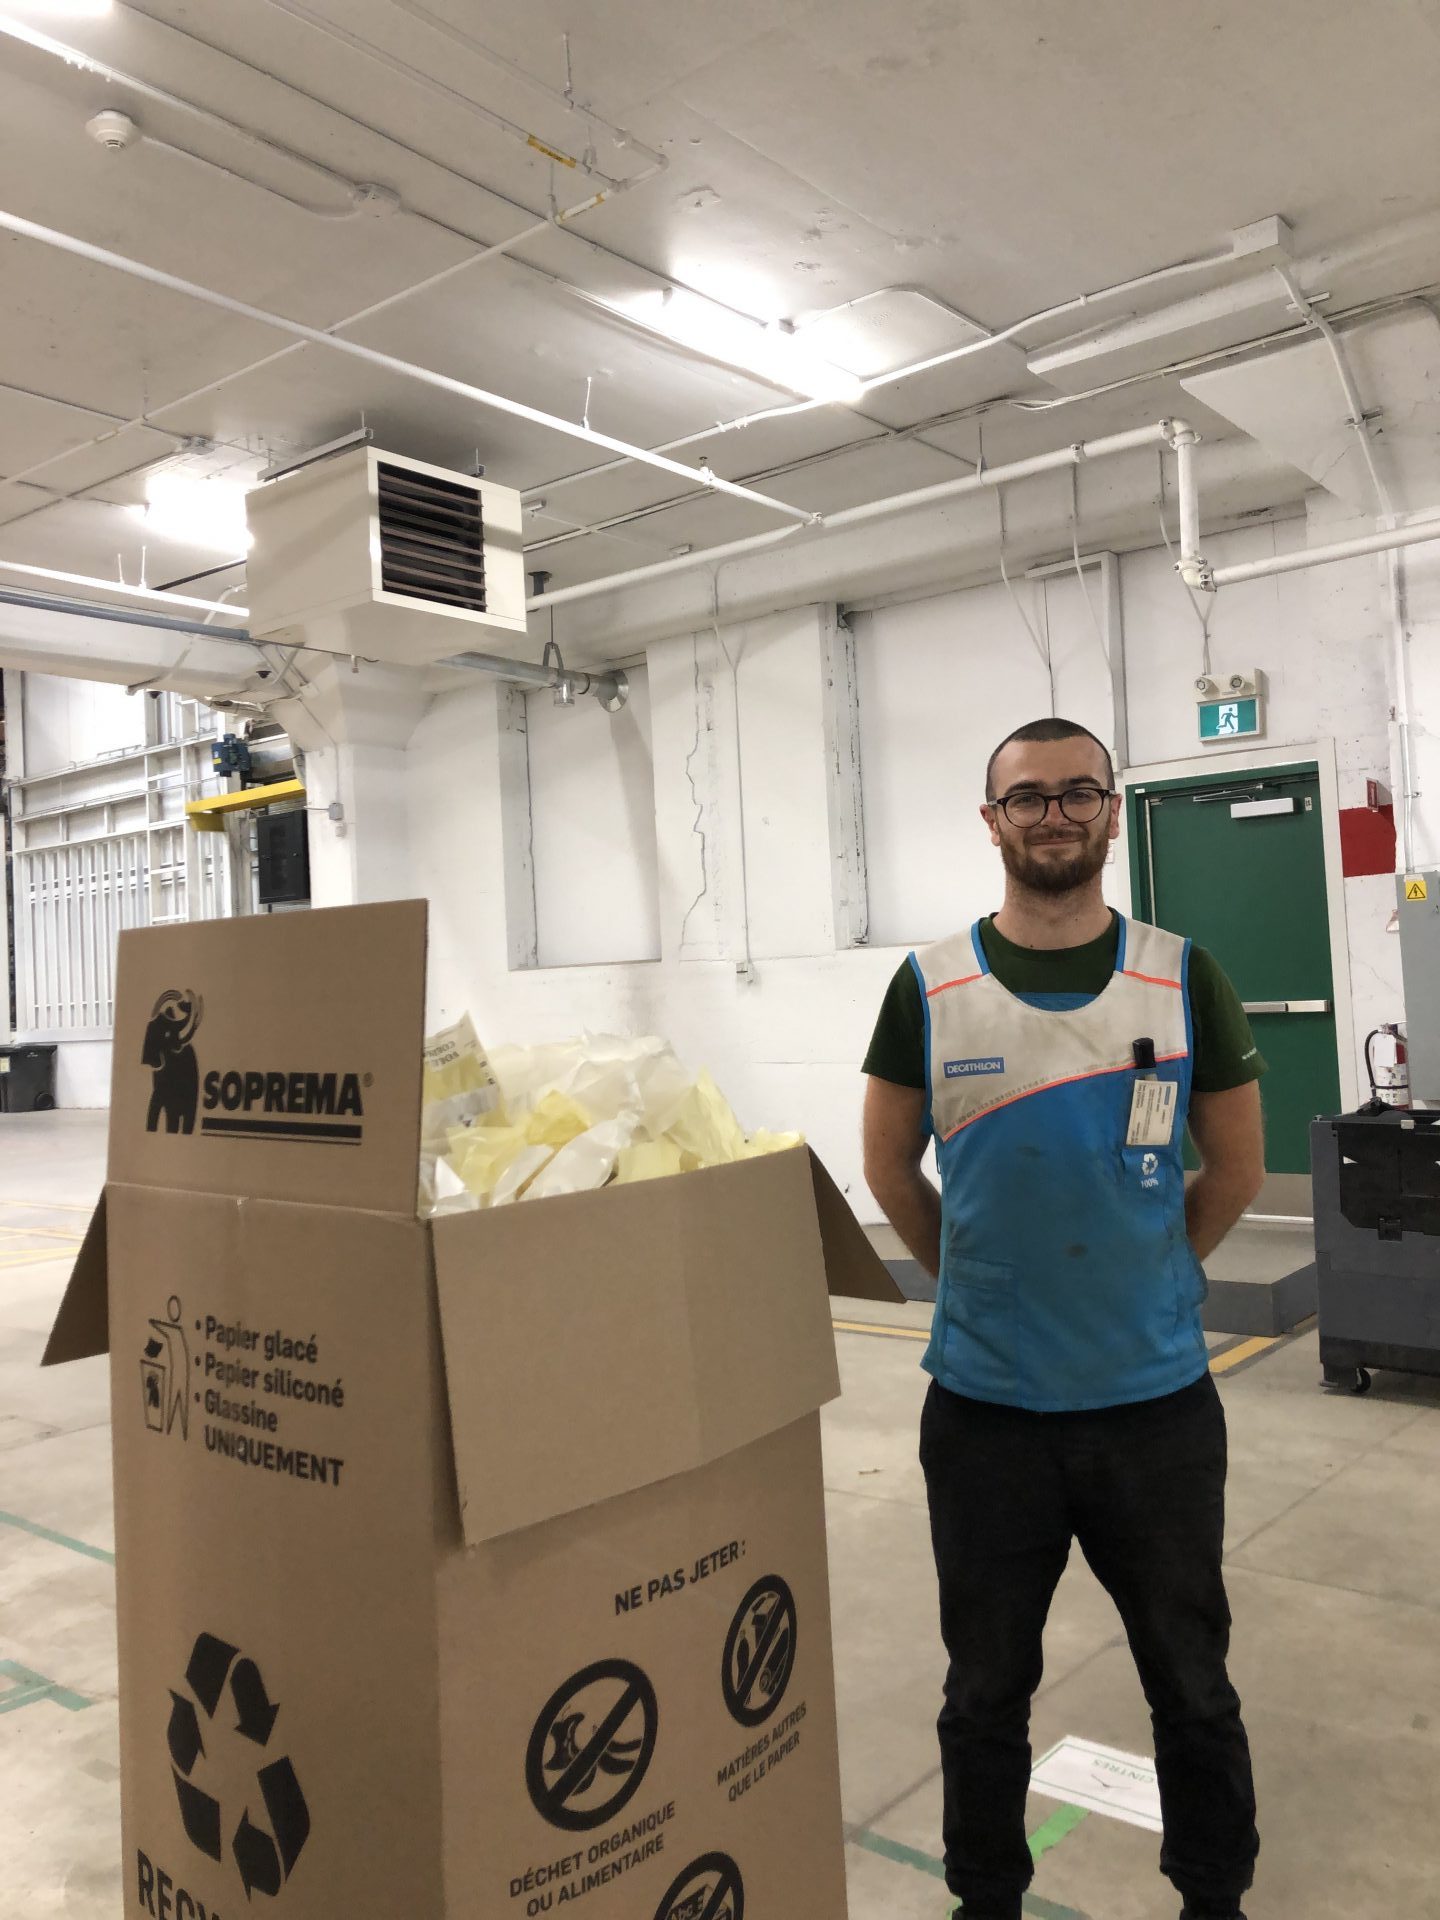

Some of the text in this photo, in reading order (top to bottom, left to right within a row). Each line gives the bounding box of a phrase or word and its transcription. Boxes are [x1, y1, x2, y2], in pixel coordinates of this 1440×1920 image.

[203, 1070, 363, 1116] SOPREMA
[946, 1061, 1001, 1074] DECATHLON
[205, 1314, 318, 1363] Papier glacé
[205, 1351, 344, 1408] Papier siliconé
[204, 1388, 278, 1432] Glassine
[204, 1424, 344, 1486] UNIQUEMENT
[615, 1585, 643, 1616] NE
[647, 1567, 686, 1602] PAS
[717, 1701, 807, 1786] MATIÈRES AUTRES
[728, 1730, 800, 1802] QUE LE PAPIER
[510, 1800, 676, 1898] DÉCHET ORGANIQUE
[526, 1832, 664, 1917] OU ALIMENTAIRE
